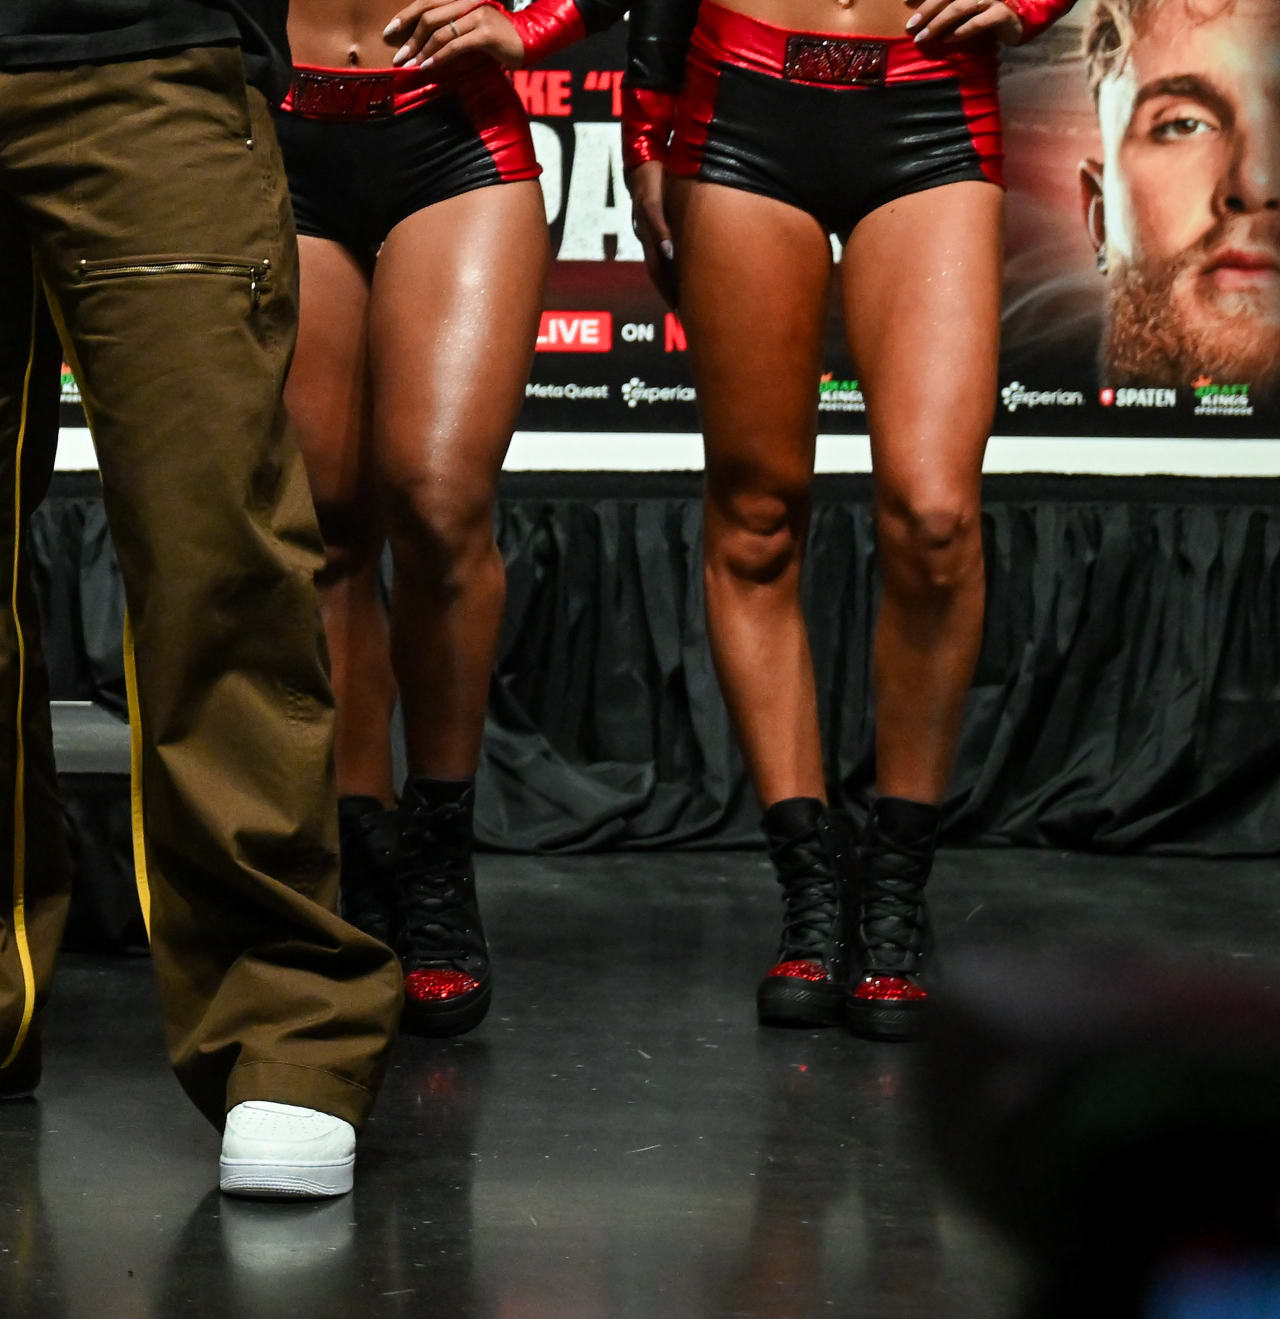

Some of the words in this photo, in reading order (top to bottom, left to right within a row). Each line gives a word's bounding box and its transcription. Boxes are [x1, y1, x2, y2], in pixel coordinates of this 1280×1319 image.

[621, 323, 655, 342] ON
[525, 384, 564, 399] Meta
[564, 384, 609, 399] Quest
[1115, 388, 1176, 408] SPATEN
